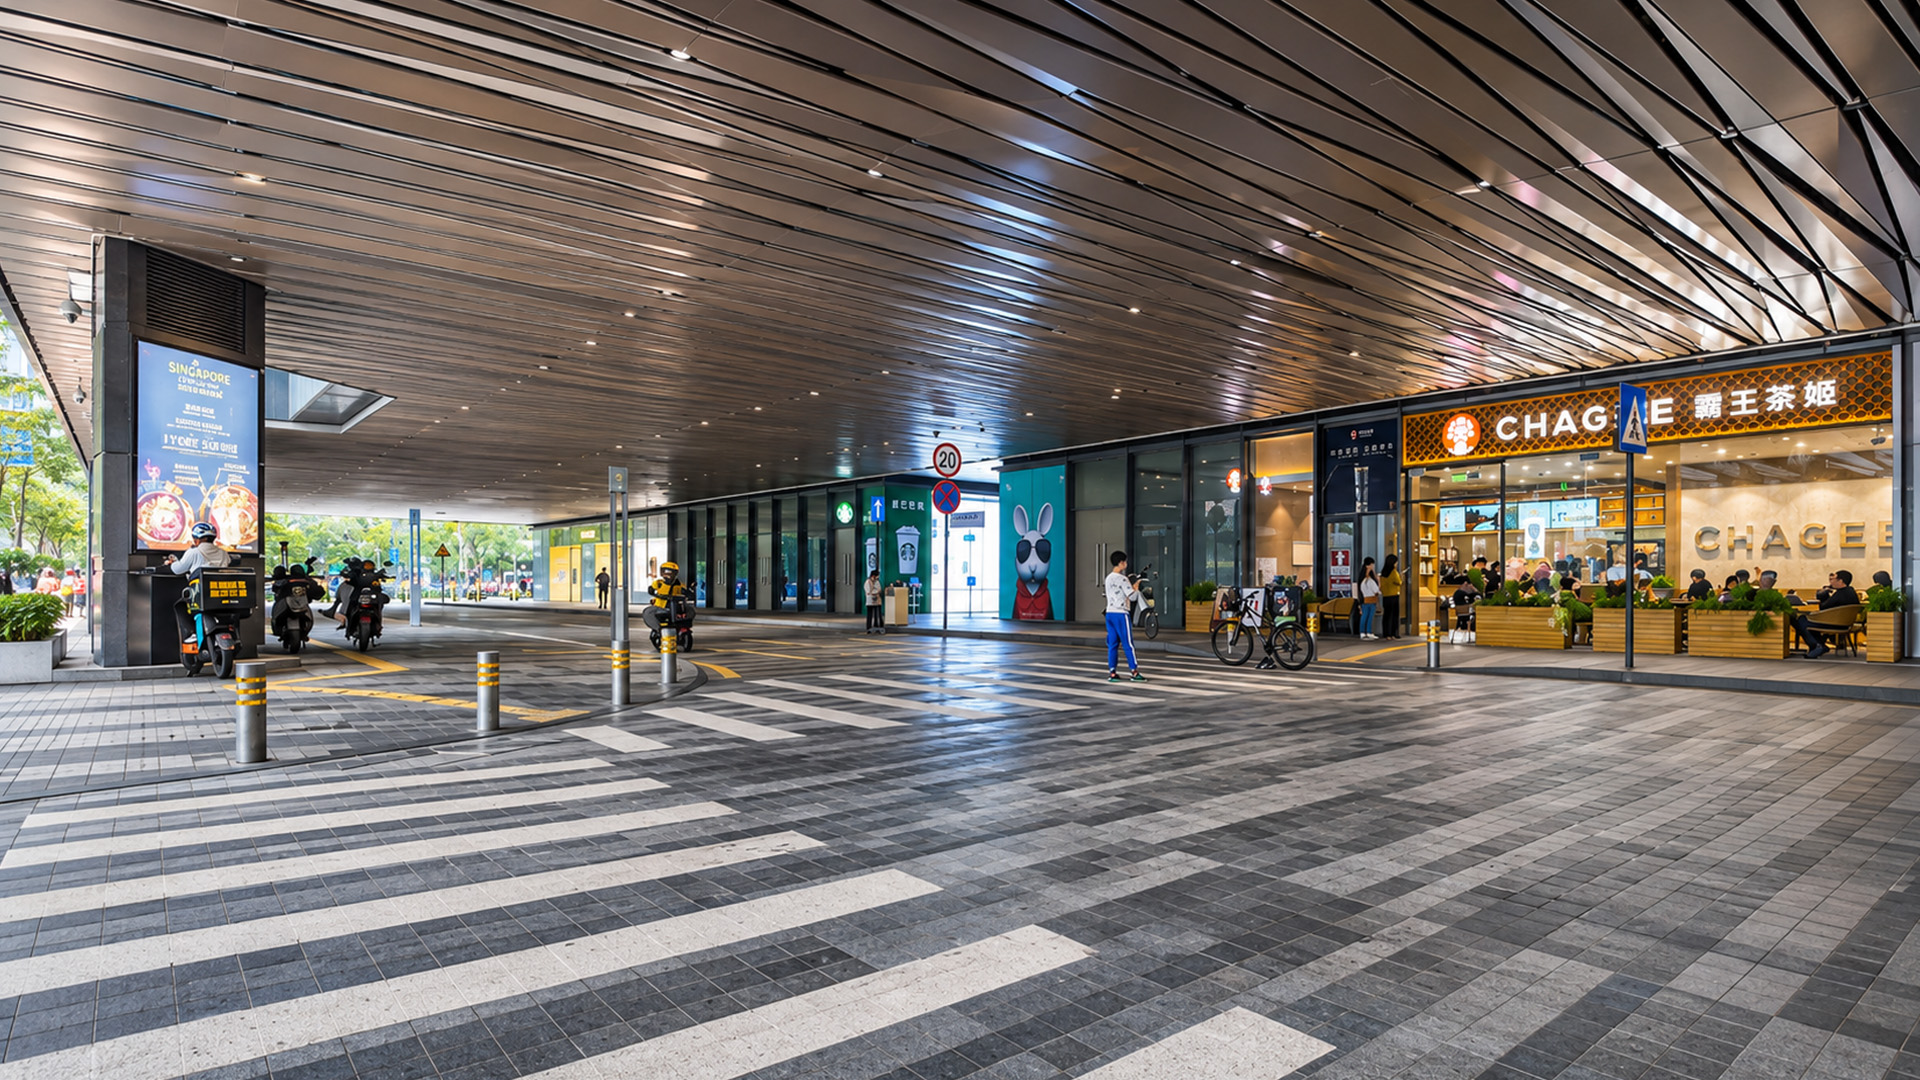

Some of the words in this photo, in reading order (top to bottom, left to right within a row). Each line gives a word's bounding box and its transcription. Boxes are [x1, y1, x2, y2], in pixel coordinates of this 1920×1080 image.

[168, 361, 231, 386] SINGAPORE
[1694, 379, 1837, 420] 霸王茶姬
[1496, 397, 1674, 441] CHAGE
[939, 451, 956, 469] 20
